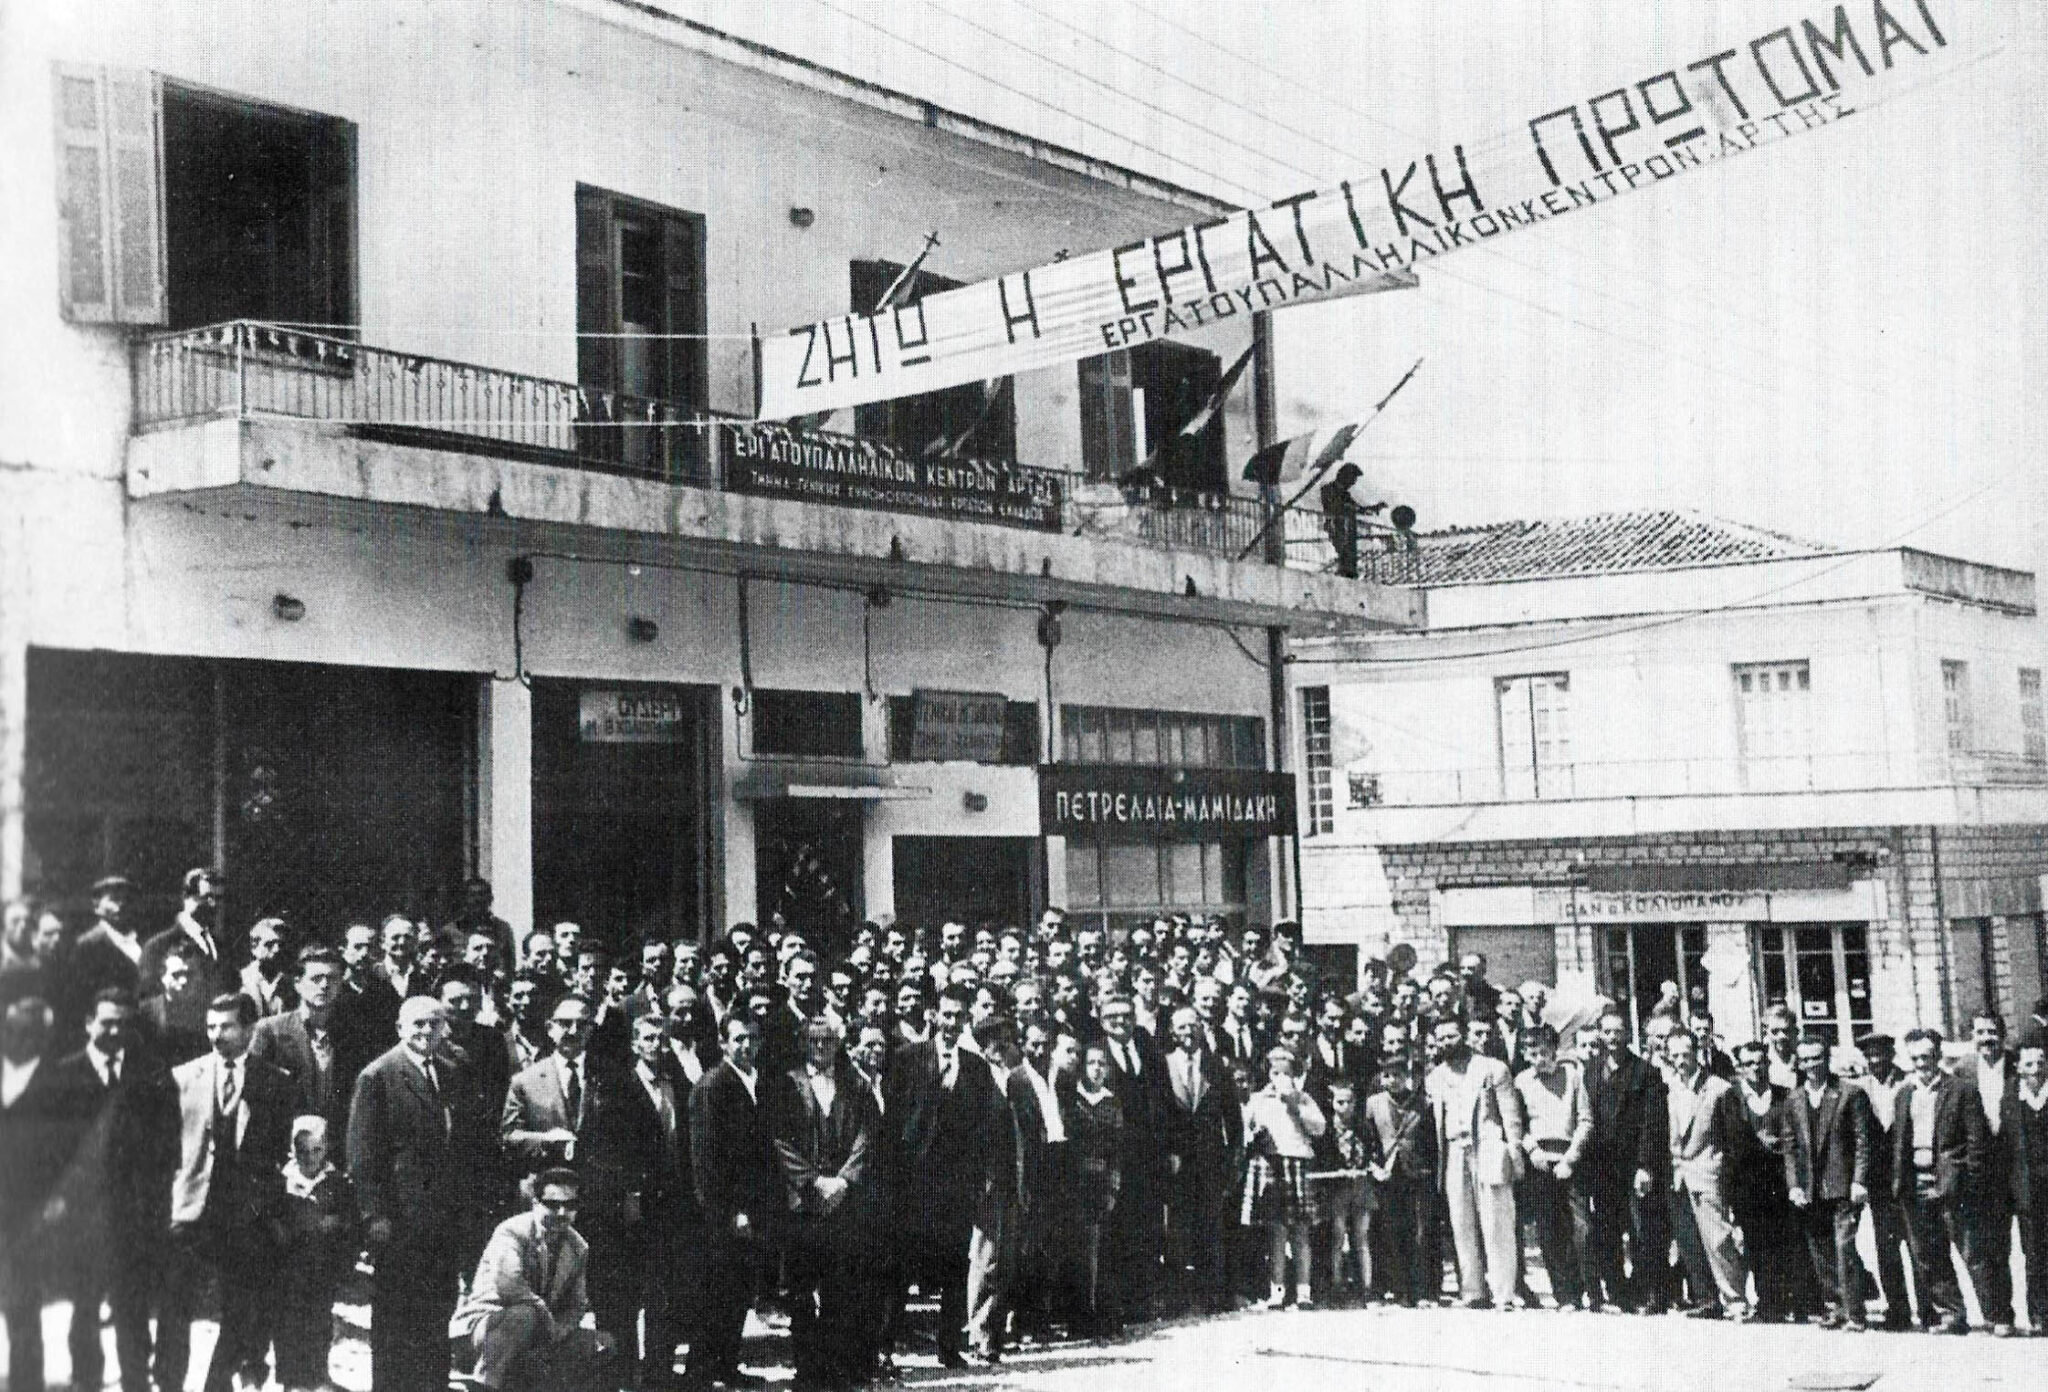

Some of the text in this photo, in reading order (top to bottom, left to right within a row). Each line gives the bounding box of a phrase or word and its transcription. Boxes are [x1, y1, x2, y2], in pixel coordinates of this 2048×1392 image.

[998, 270, 1041, 345] Η
[1112, 143, 1485, 317] ΕΡΓΑΤΙΚΗ
[926, 463, 996, 492] ΚΕΝΤΡΟΝ
